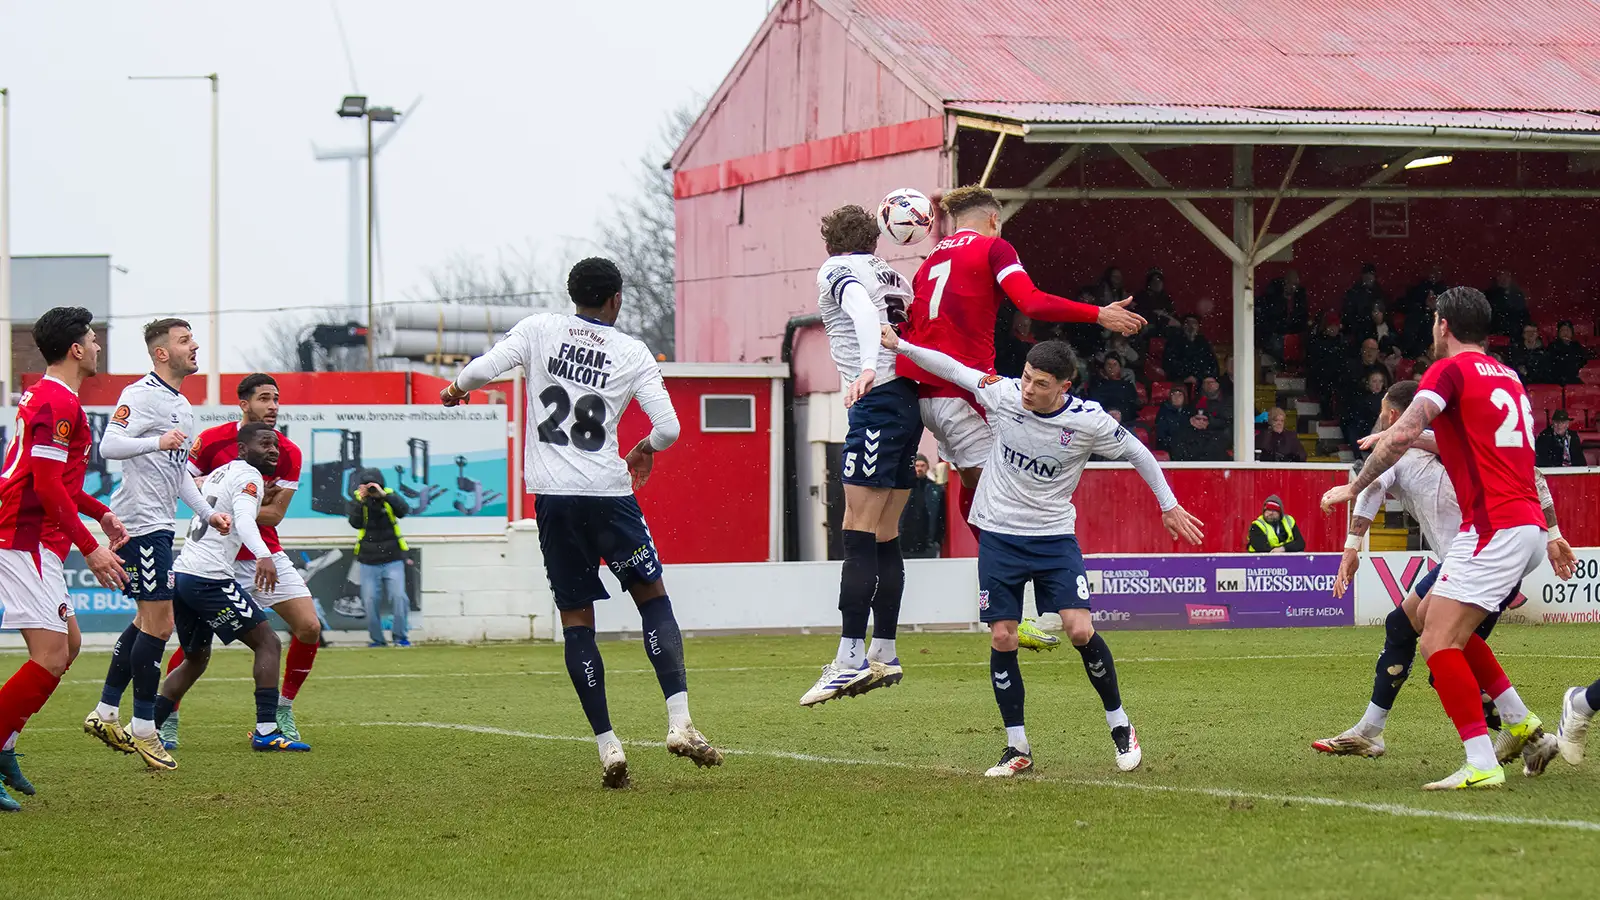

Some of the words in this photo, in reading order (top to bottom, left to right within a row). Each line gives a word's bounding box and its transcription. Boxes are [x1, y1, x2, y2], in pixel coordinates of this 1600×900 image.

[928, 260, 952, 320] 7
[557, 342, 612, 370] FAGAN-
[548, 356, 610, 388] WALCOTT
[1474, 362, 1522, 385] DALL
[336, 410, 499, 422] www.bronze-mitsubishi.co.uk
[538, 385, 606, 452] 28
[843, 452, 858, 478] 5
[1002, 443, 1057, 478] TITAN
[1103, 570, 1149, 578] GRAVESEND
[1247, 568, 1288, 576] DARTFORD
[1076, 575, 1090, 600] 8
[1103, 577, 1207, 594] MESSENGER
[1217, 581, 1239, 591] KM
[1543, 583, 1578, 604] 037
[1089, 609, 1131, 621] ntOnline
[1316, 608, 1345, 616] MEDIA
[1542, 609, 1600, 624] www.vmclt
